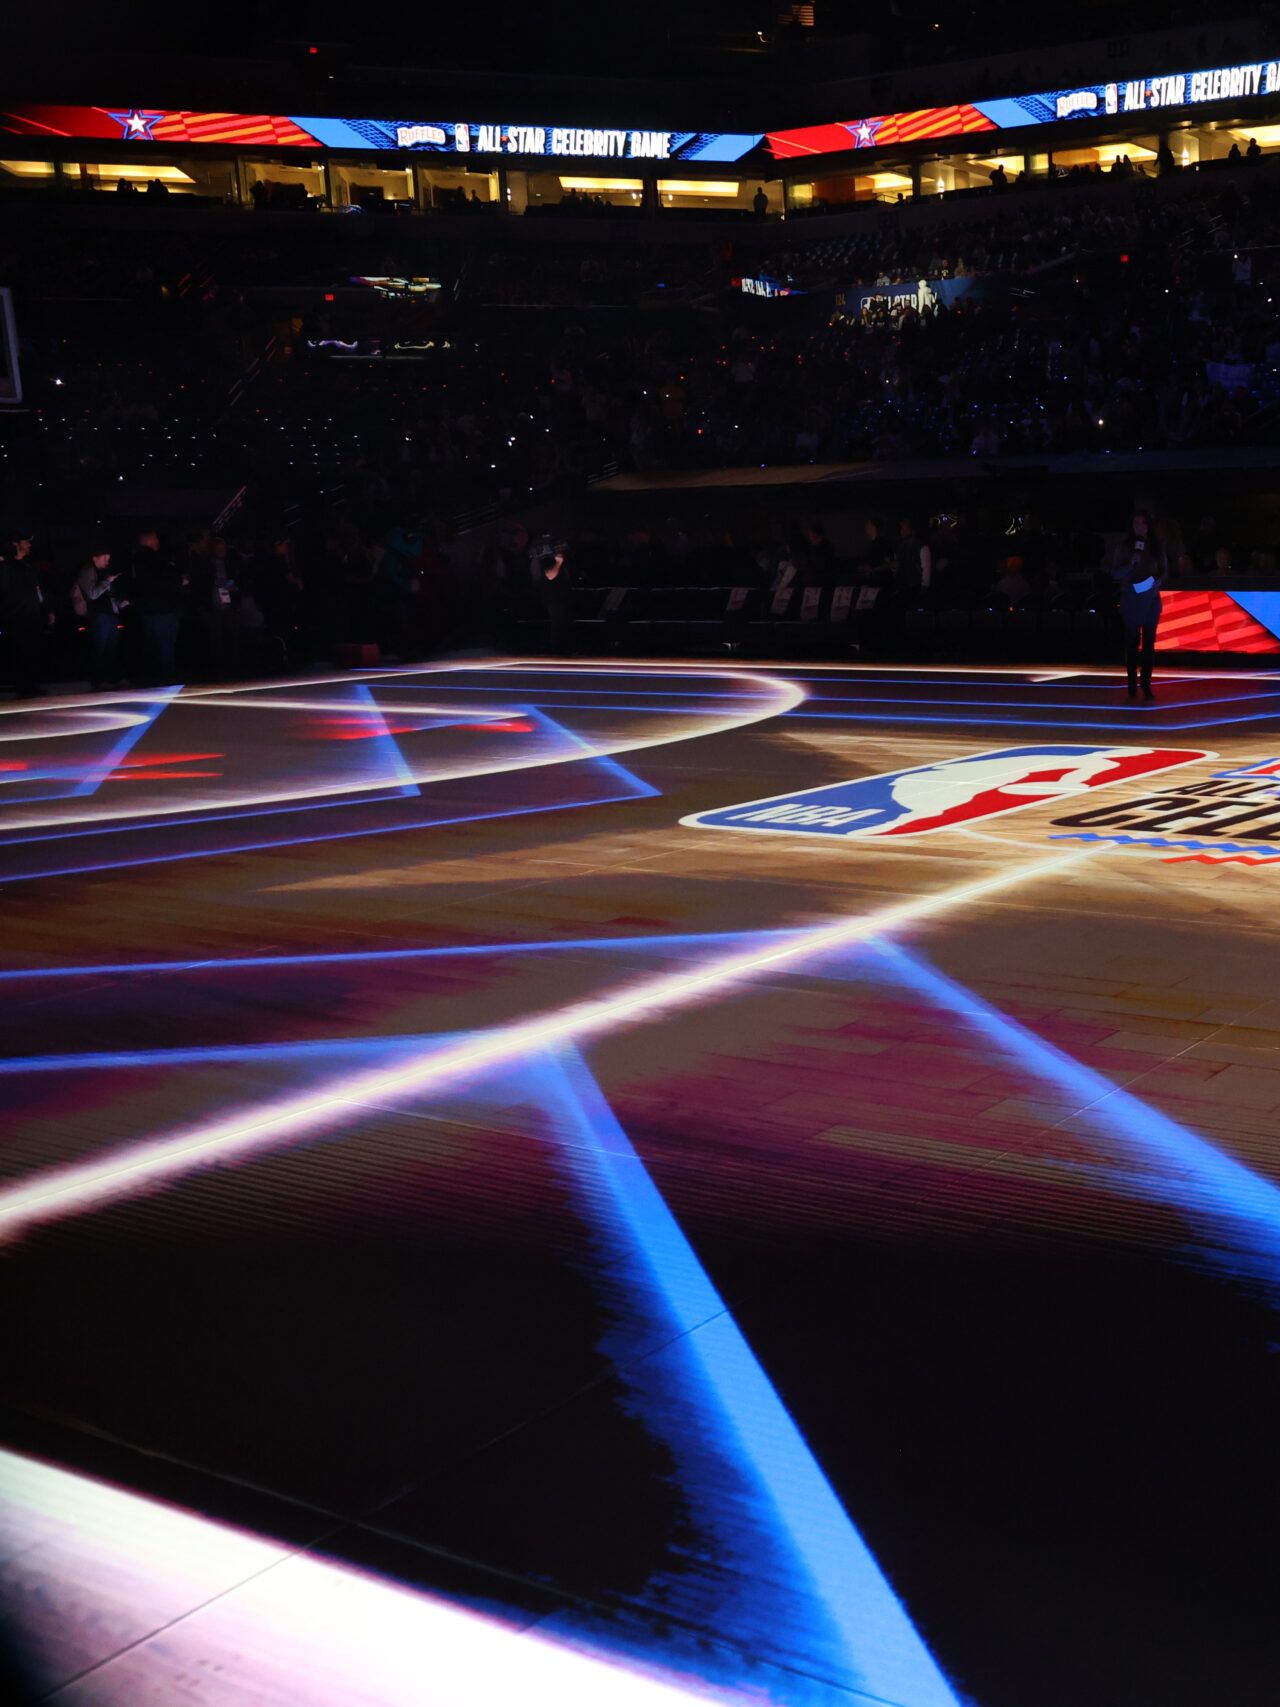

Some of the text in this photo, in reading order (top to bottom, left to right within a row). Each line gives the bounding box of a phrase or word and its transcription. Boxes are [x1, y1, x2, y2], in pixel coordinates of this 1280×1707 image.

[1124, 80, 1147, 111] ALL
[1150, 75, 1185, 107] STAR
[1191, 64, 1262, 102] CELEBRITY
[399, 127, 445, 145] RUFFLES
[478, 125, 670, 158] ALL STAR CELEBRITY GAME
[724, 803, 887, 828] NBA
